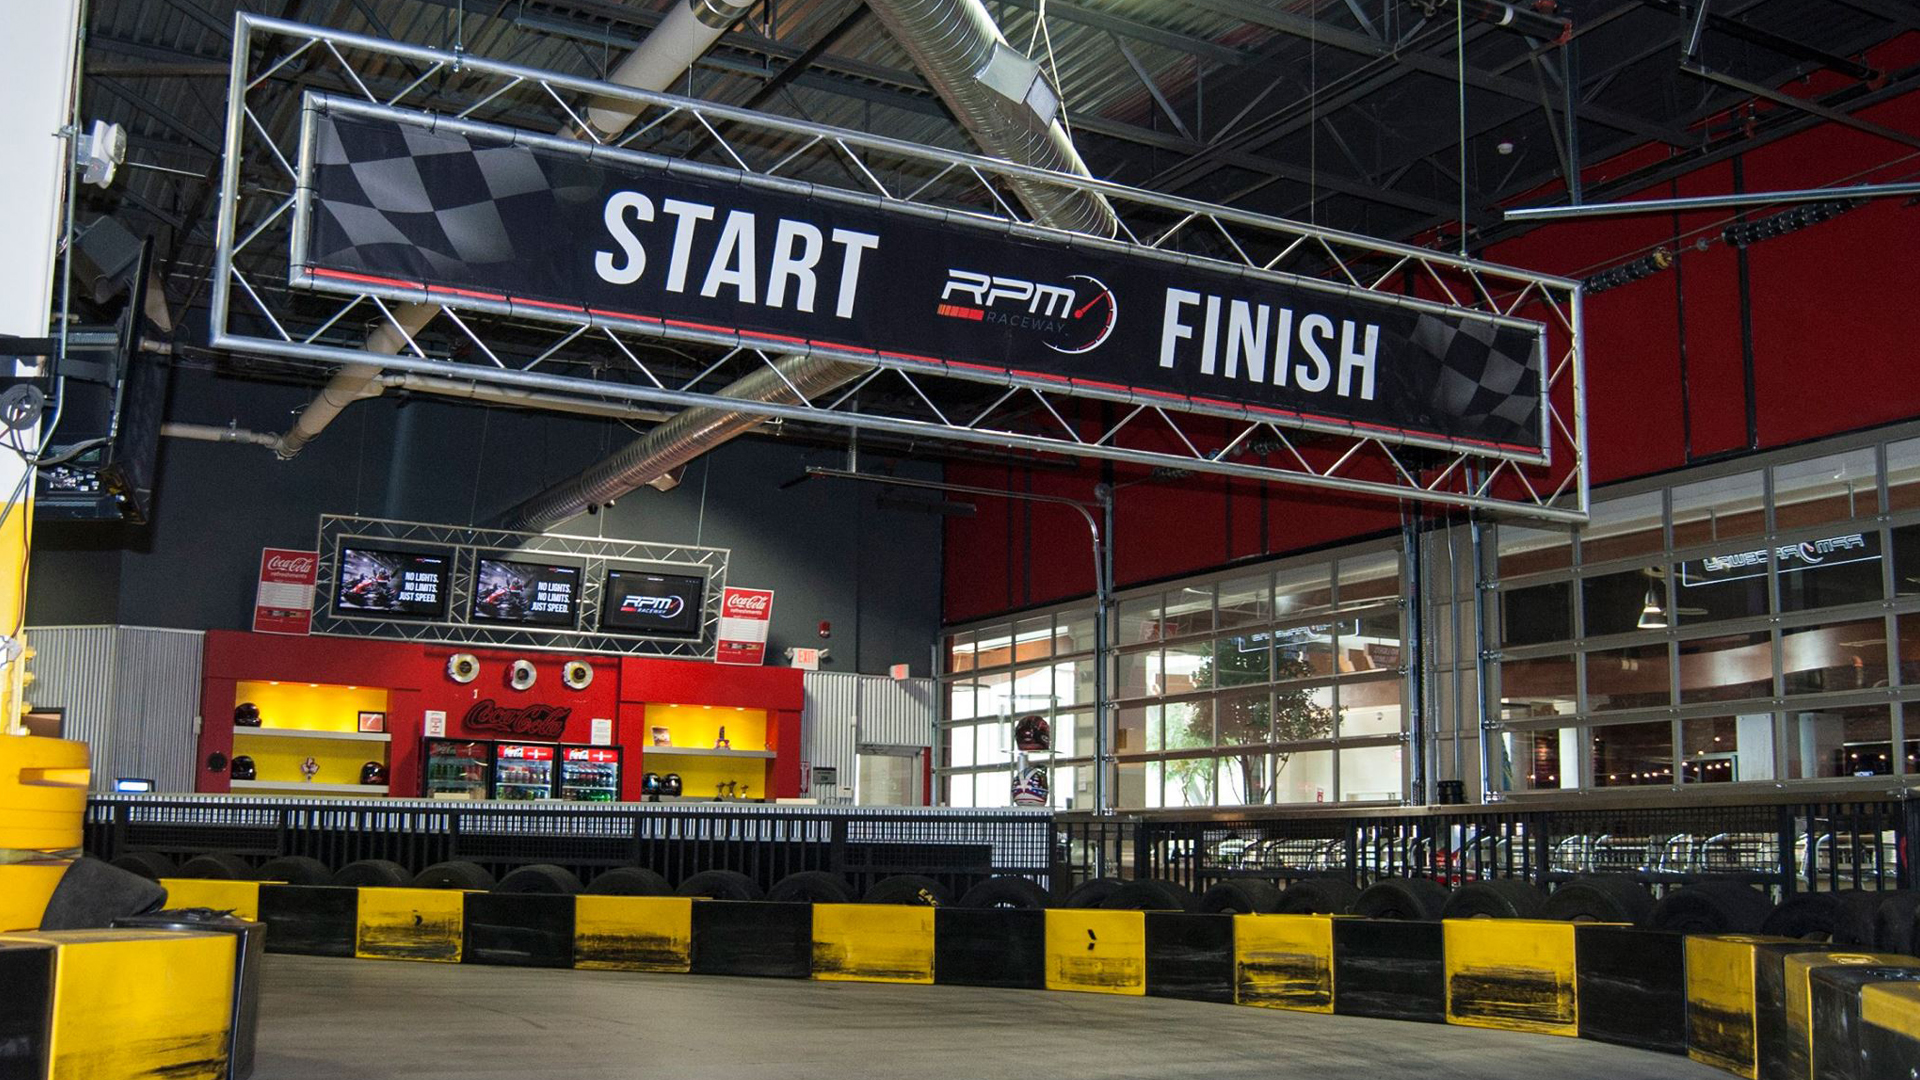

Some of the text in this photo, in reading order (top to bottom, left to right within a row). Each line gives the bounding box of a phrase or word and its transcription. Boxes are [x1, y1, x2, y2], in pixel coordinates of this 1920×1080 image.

[594, 190, 880, 319] START
[941, 268, 1076, 319] RPM
[986, 311, 1066, 333] RACEWAY
[1159, 287, 1379, 400] FINISH
[405, 571, 439, 583] NO LIGHTS.
[404, 581, 438, 593] NO LIMITS.
[538, 581, 571, 593] NO LIGHTS.
[398, 591, 437, 603] JUST SPEED.
[537, 591, 570, 603] NO LIMITS.
[622, 595, 673, 609] RPM
[530, 601, 569, 613] JUST SPEED.
[797, 649, 817, 664] EXIT
[464, 699, 572, 737] Coca-Cola
